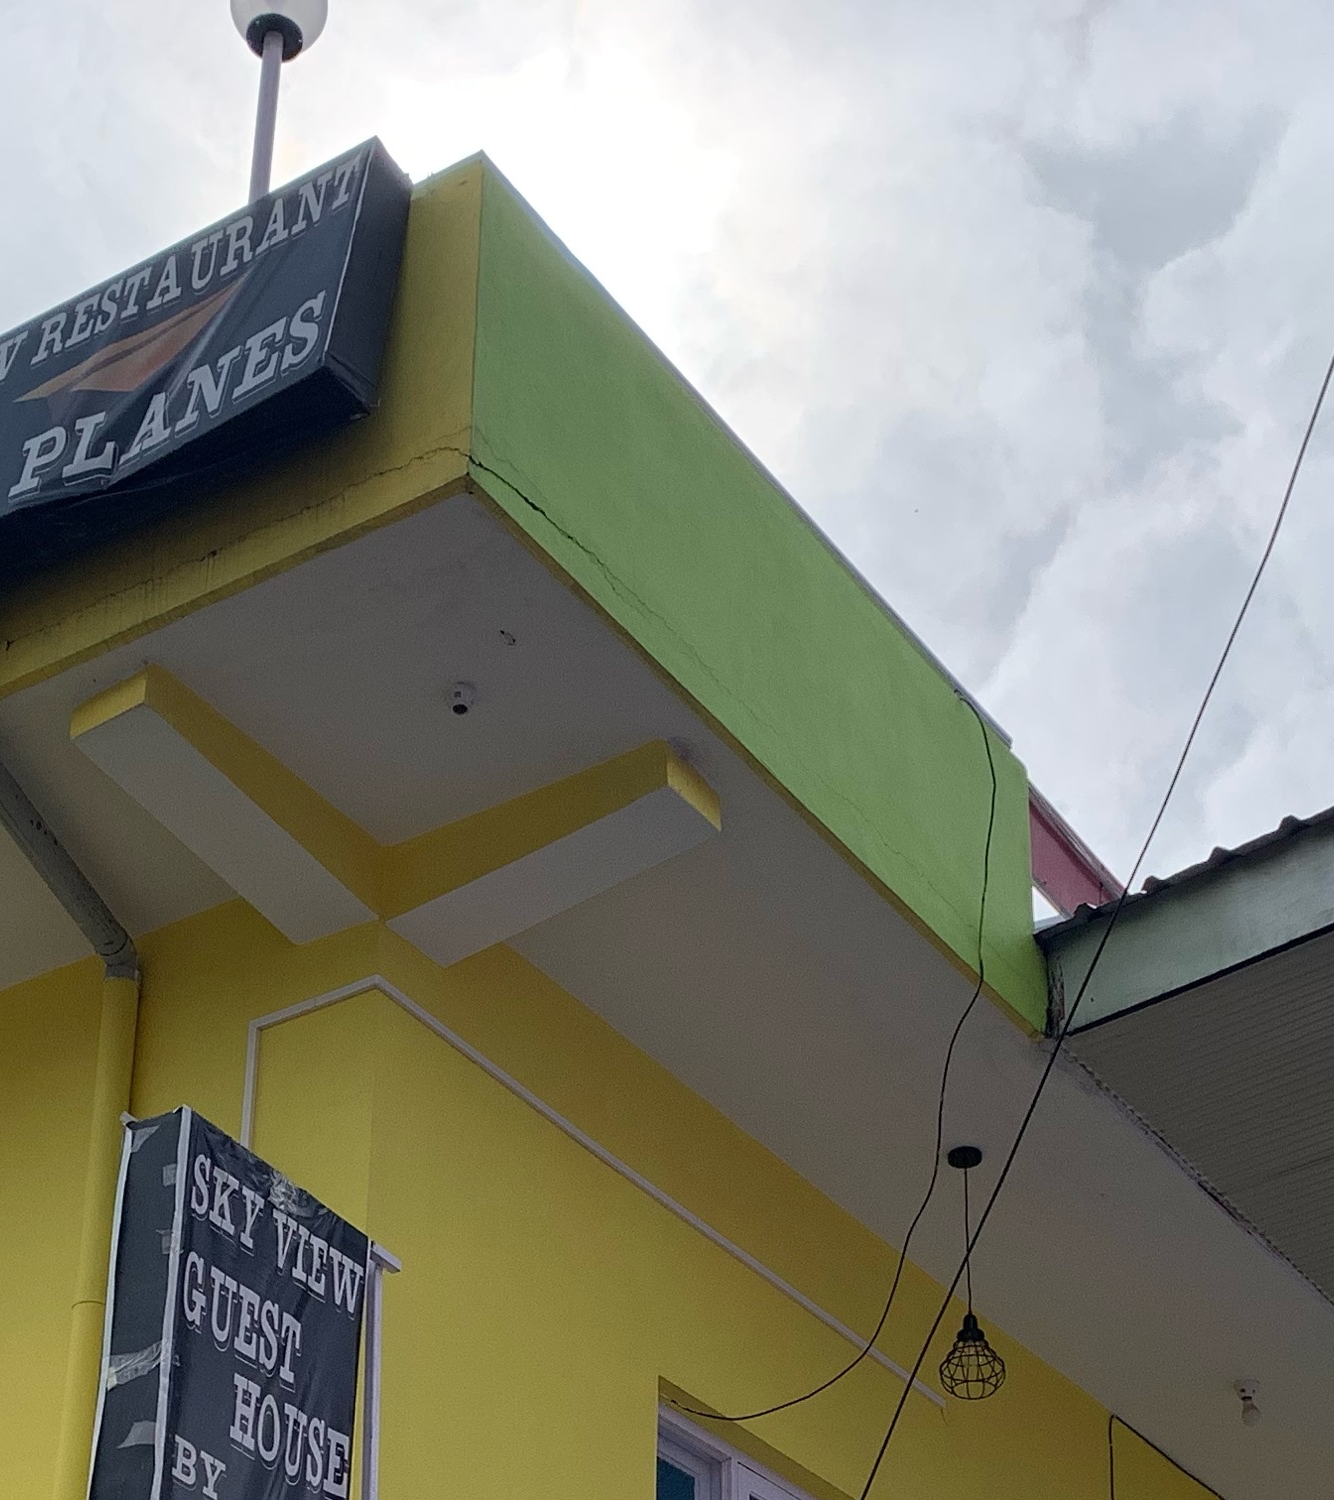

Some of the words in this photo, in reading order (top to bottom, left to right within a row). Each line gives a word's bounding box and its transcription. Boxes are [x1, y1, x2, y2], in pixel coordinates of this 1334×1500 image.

[30, 160, 360, 365] RESTAURANT
[7, 290, 327, 500] PLANES
[183, 1251, 302, 1390] GUEST
[190, 1154, 265, 1252] SKY
[272, 1207, 365, 1317] VIEW
